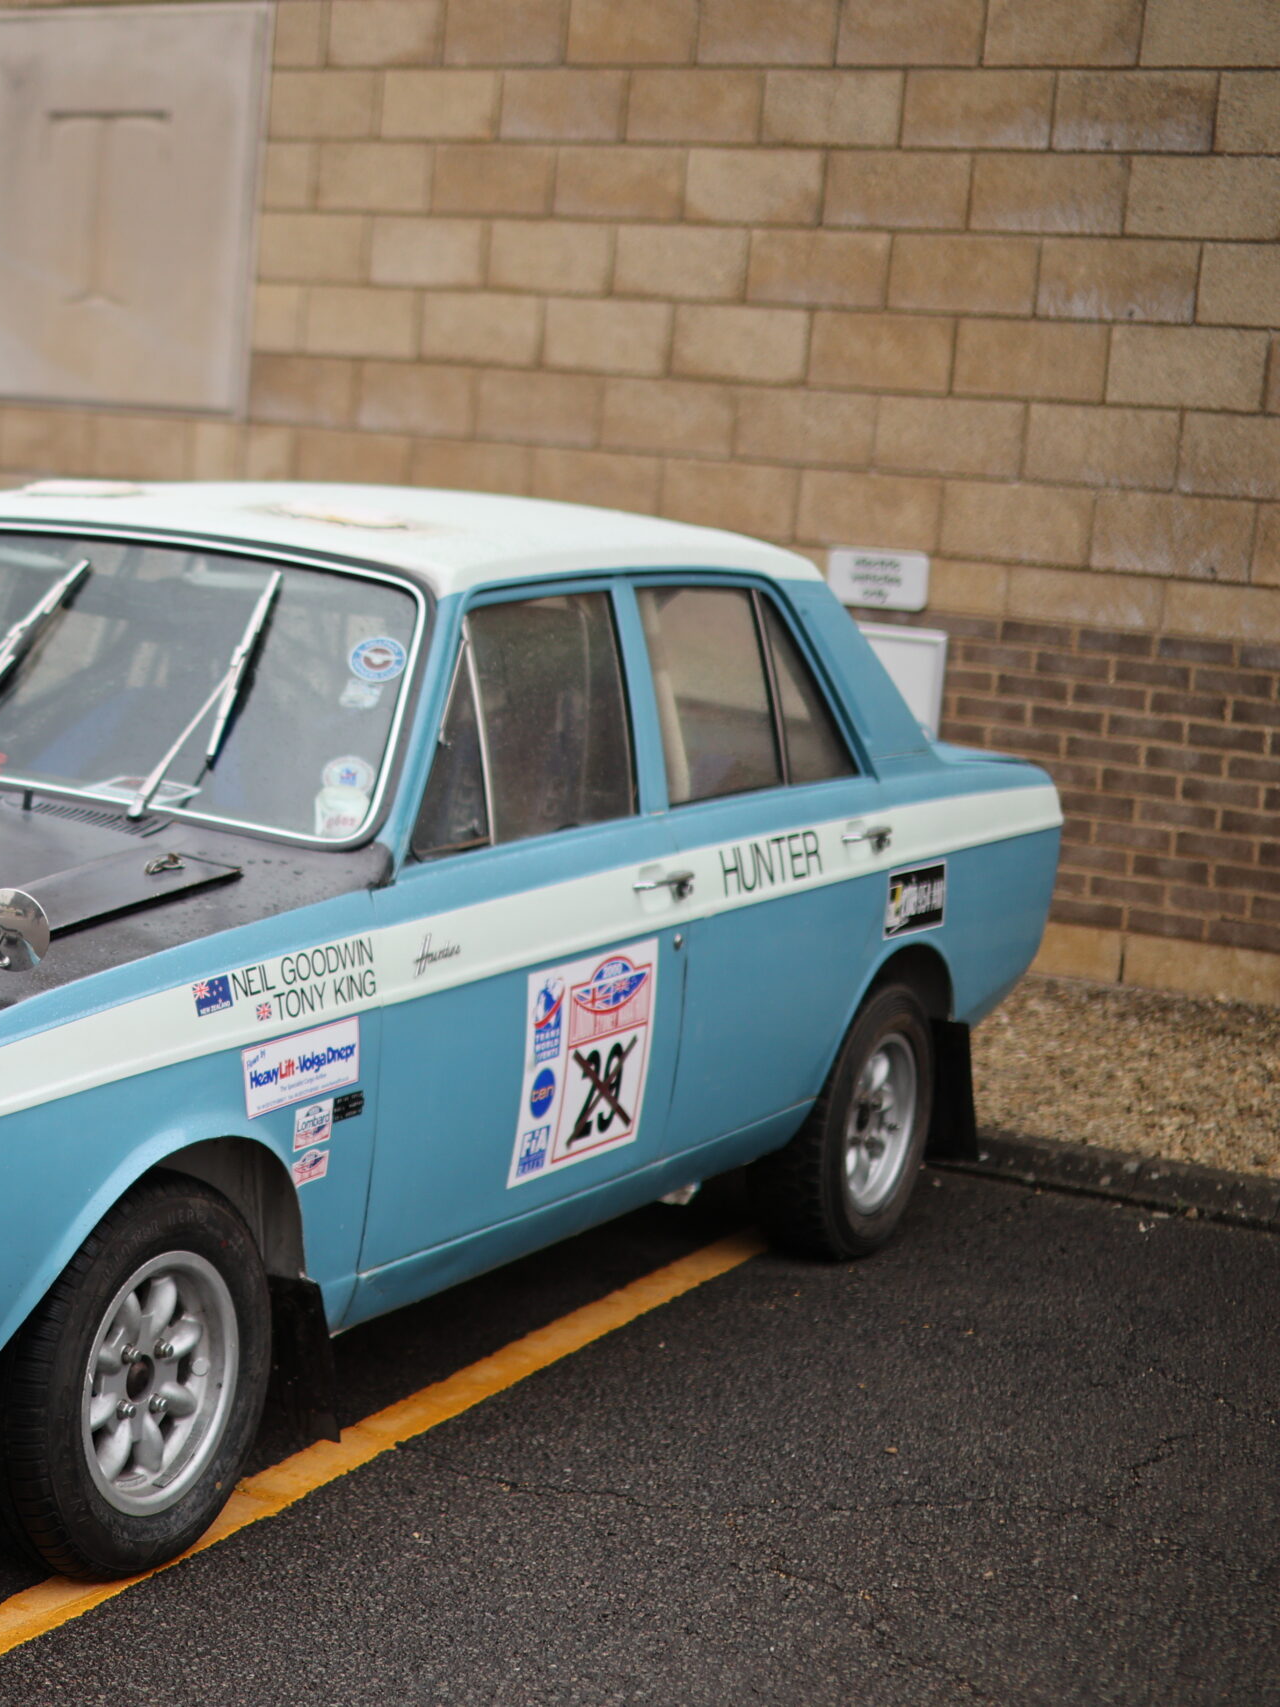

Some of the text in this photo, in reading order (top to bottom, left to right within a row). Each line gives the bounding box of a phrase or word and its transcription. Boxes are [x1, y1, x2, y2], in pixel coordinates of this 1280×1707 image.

[43, 108, 175, 306] T
[719, 830, 823, 897] HUNTER
[231, 937, 375, 1001] NEIL GOODWIN
[273, 969, 376, 1020] TONY KING
